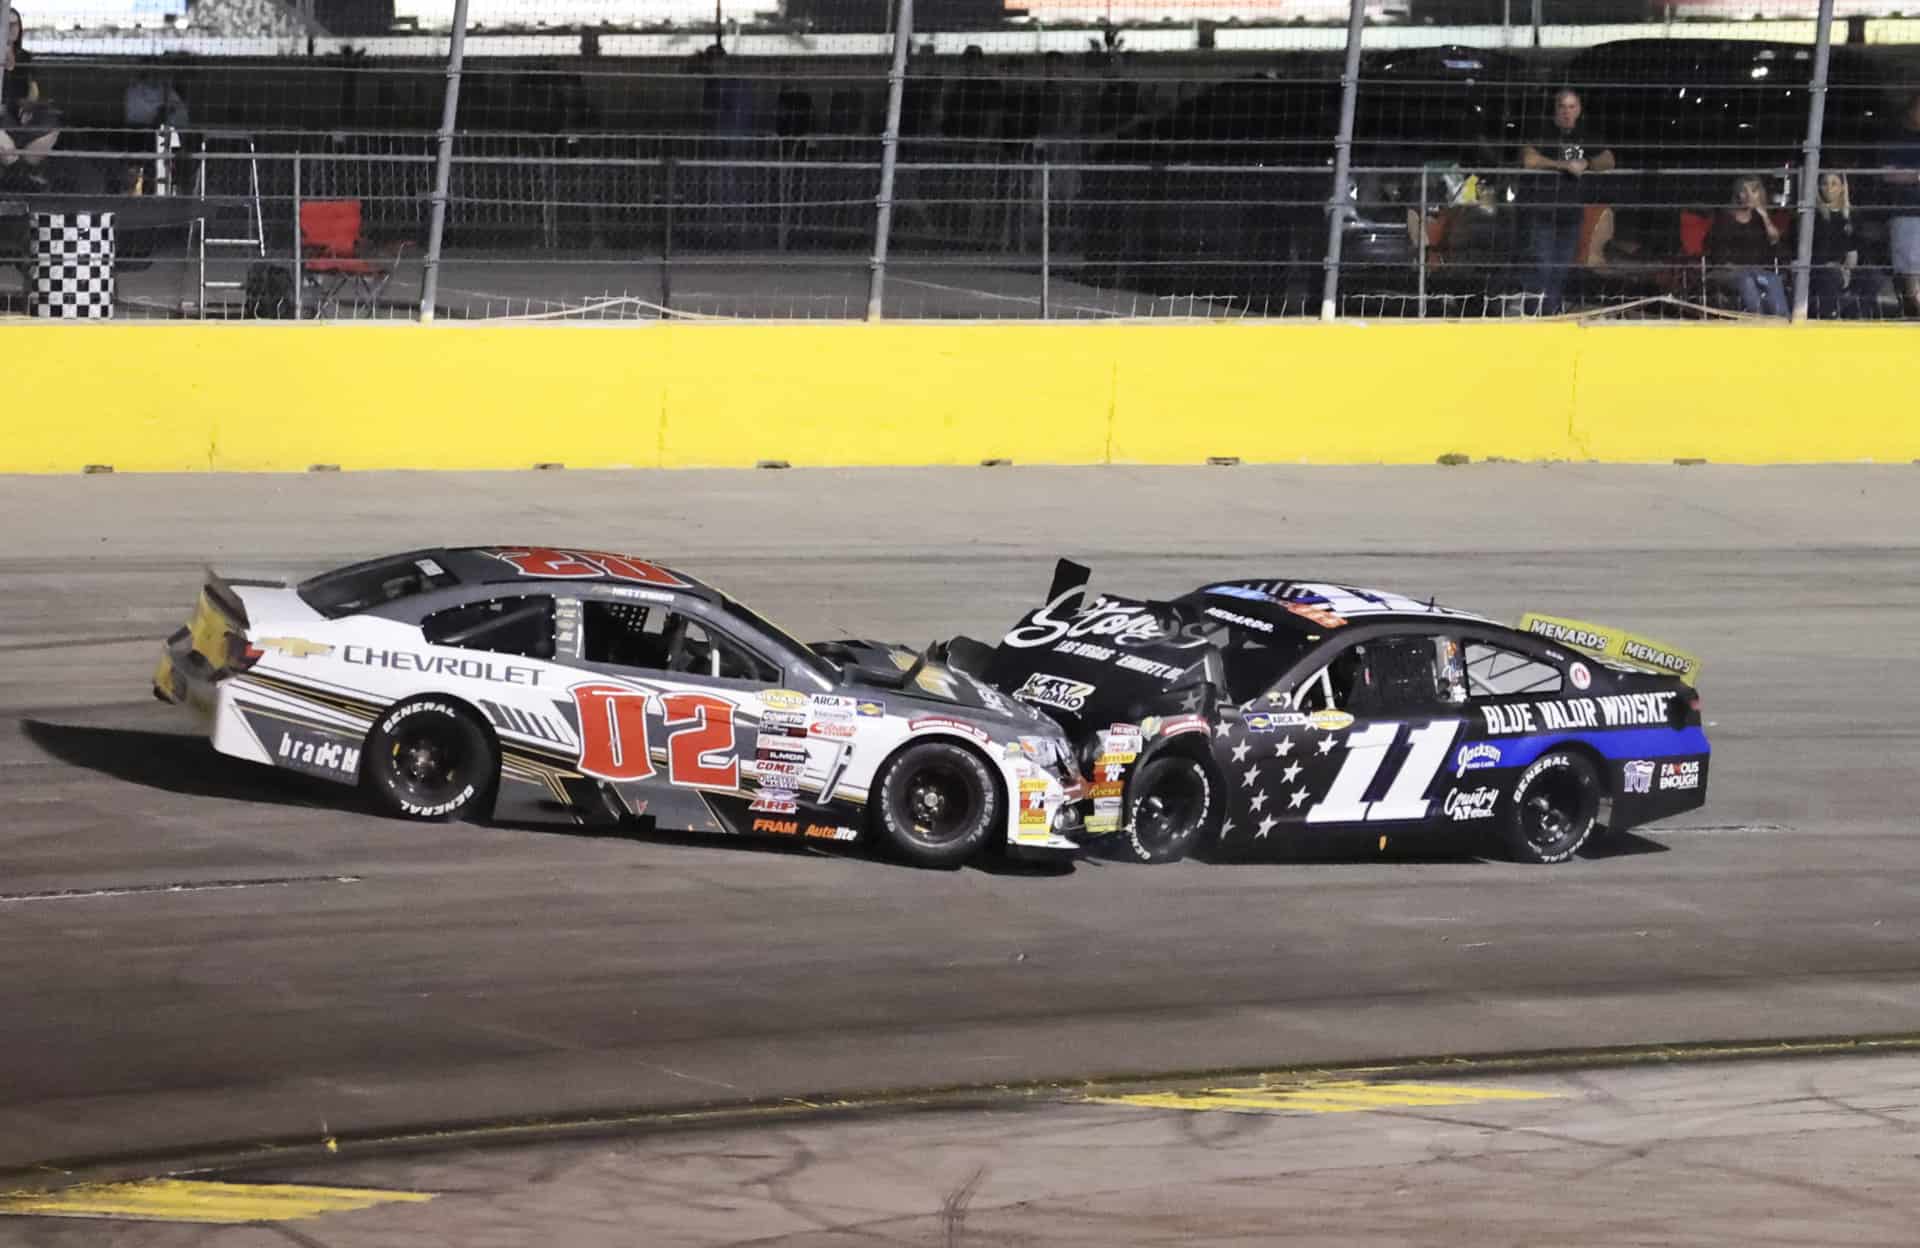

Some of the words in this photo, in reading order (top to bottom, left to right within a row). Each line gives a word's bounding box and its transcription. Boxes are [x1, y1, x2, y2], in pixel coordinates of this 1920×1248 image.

[1530, 619, 1609, 650] MENARDS
[343, 645, 544, 686] CHEVROLET
[1623, 641, 1692, 673] MENARDS
[813, 695, 840, 706] ARCA
[1480, 703, 1537, 735] BLUE
[1535, 697, 1599, 731] VALOR
[1595, 691, 1677, 727] WHISKE
[382, 701, 456, 735] GENERAL
[568, 681, 740, 790] 02
[756, 761, 794, 774] COMP
[1306, 719, 1460, 823] 11
[1513, 756, 1570, 803] GENERAL
[400, 784, 475, 817] GENERAL
[751, 800, 796, 811] ARP
[752, 819, 798, 834] FRAM
